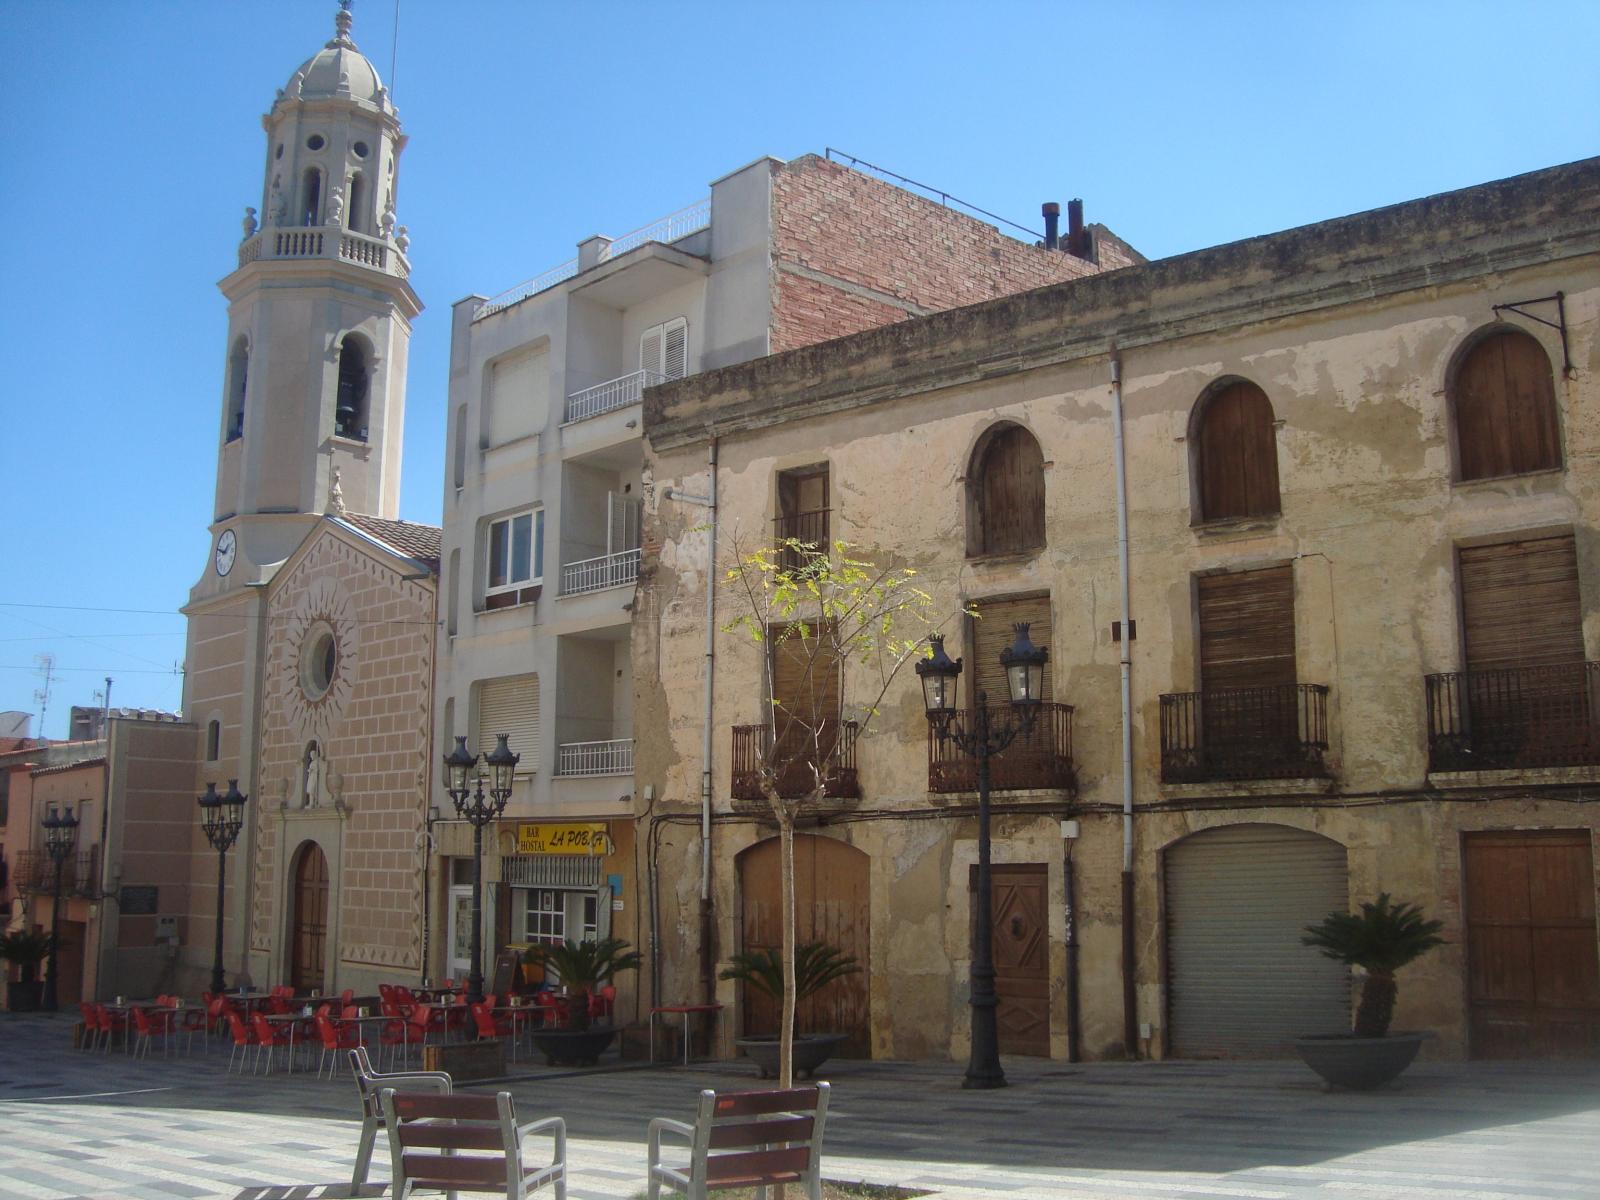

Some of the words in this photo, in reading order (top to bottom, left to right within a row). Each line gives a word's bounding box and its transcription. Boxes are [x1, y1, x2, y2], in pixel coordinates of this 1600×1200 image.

[526, 826, 540, 838] BAR
[549, 831, 564, 846] LA
[567, 831, 603, 847] POBA
[520, 840, 546, 852] HOSTAL
